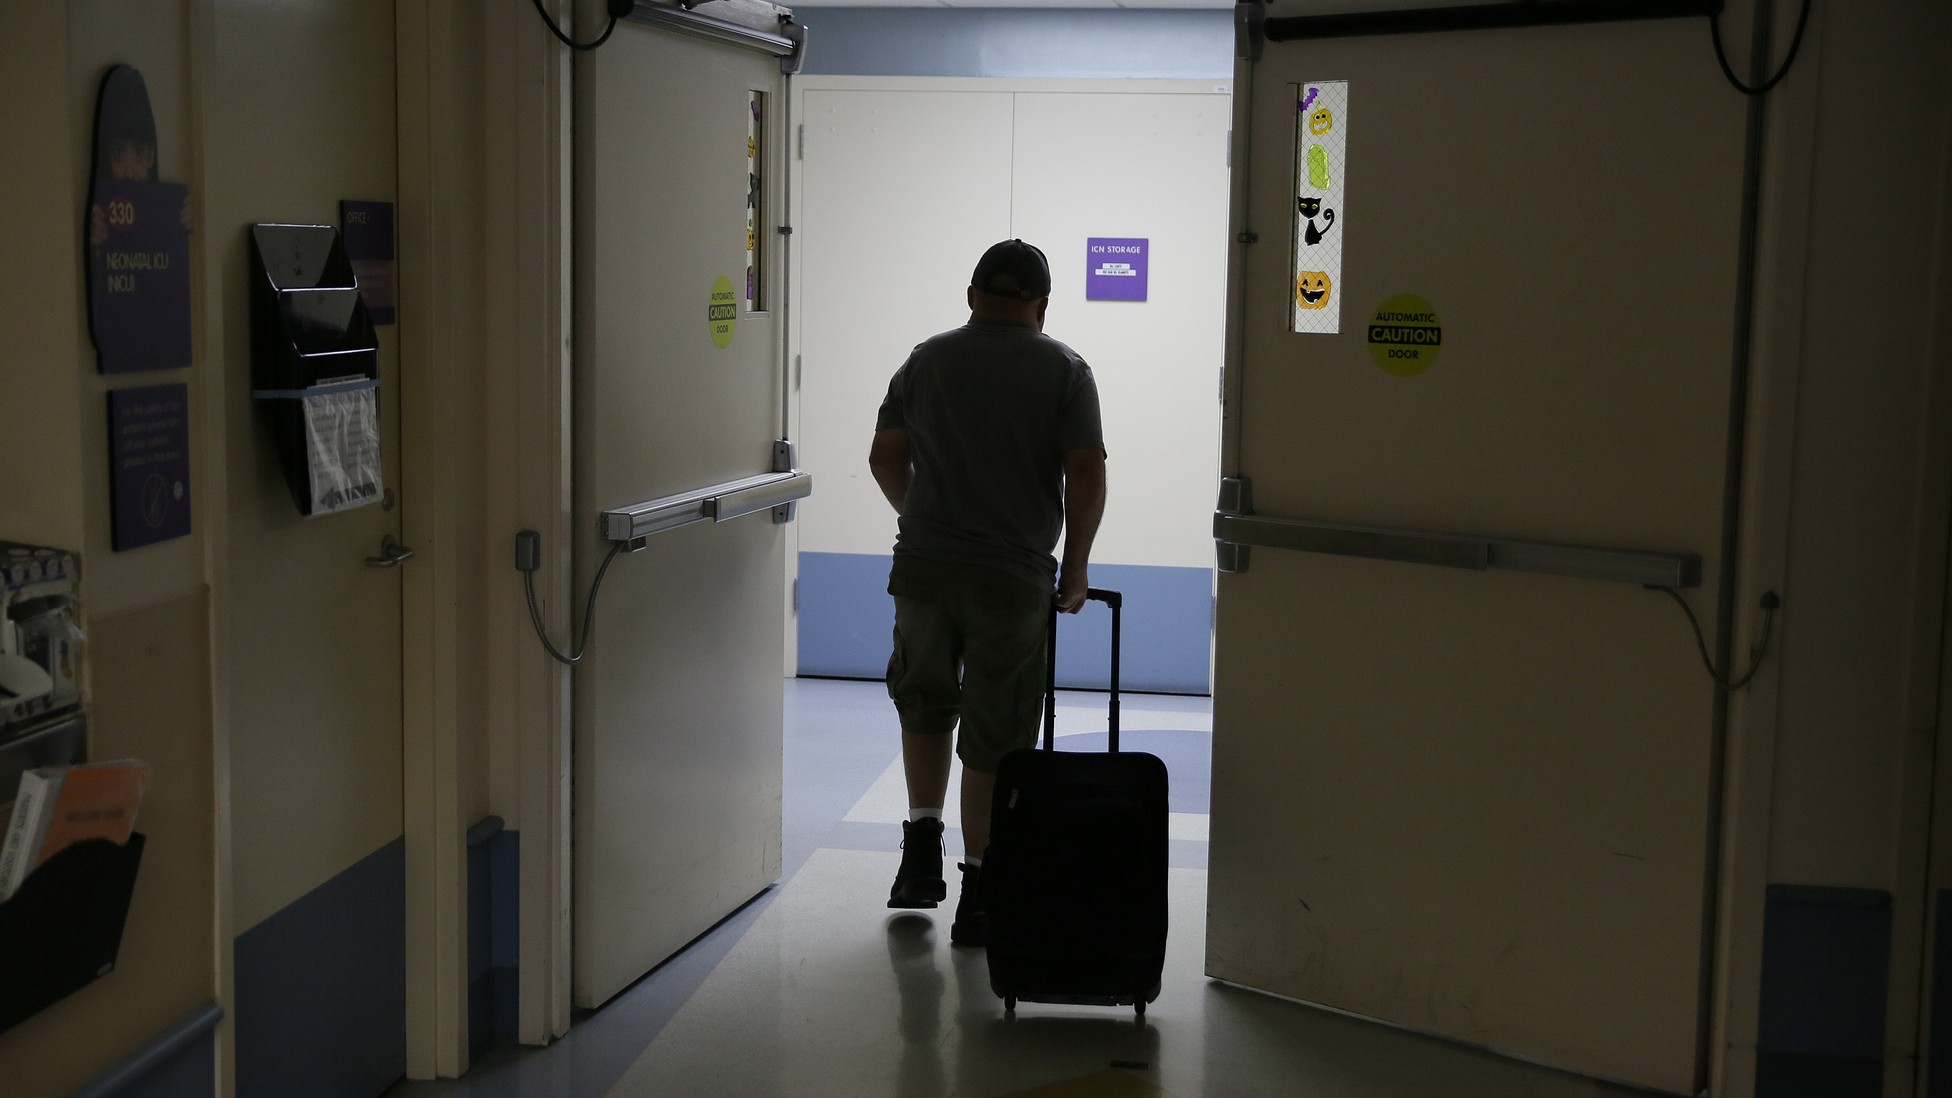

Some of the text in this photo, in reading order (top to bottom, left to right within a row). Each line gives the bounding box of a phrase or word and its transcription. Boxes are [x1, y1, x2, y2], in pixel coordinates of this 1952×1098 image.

[109, 201, 133, 224] 330
[347, 211, 367, 224] OFFICE
[1091, 245, 1140, 254] ICN STORAGE
[106, 252, 169, 270] NEONATAL ICU
[711, 292, 734, 300] AUTOMATIC
[710, 305, 736, 320] CAUTION
[1376, 312, 1436, 323] AUTOMATIC
[716, 325, 728, 333] DOOR
[1371, 327, 1439, 343] CAUTION
[1388, 349, 1419, 359] DOOR
